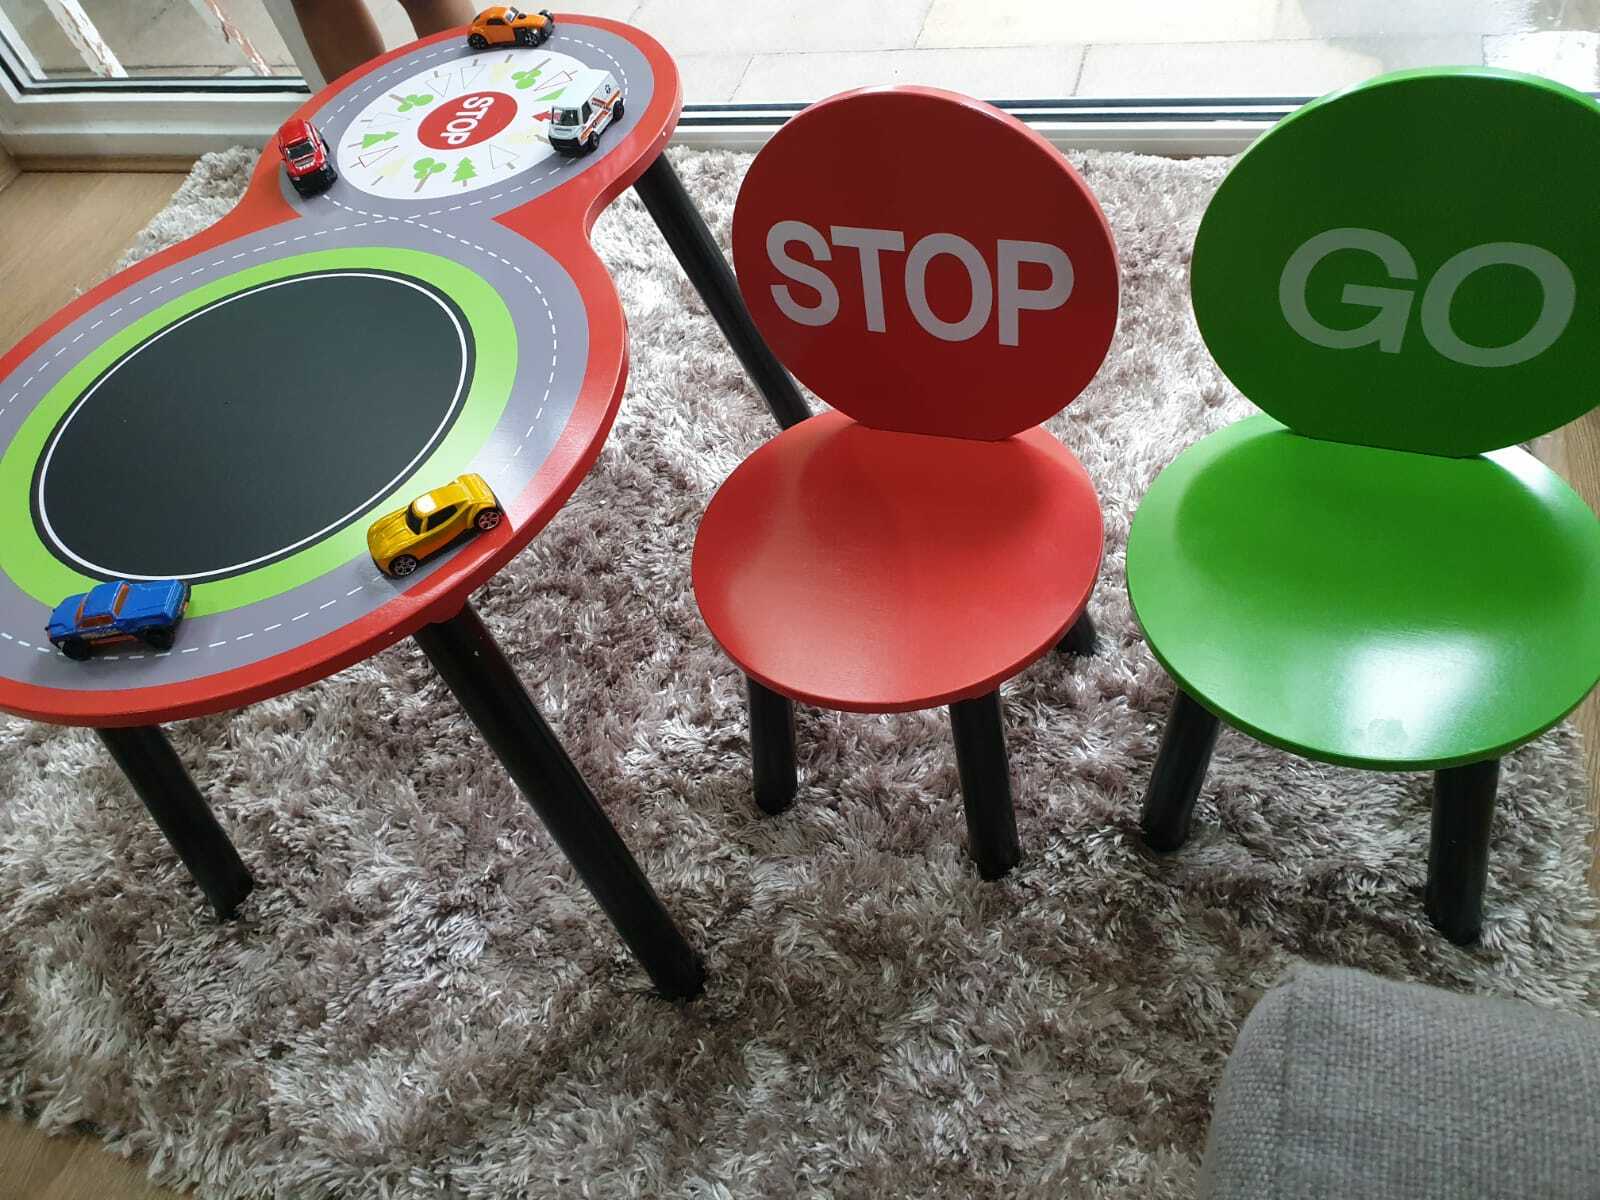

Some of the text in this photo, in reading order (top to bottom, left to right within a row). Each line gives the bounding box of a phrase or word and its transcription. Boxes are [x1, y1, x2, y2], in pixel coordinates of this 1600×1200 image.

[440, 96, 495, 145] STOP
[765, 220, 1075, 347] STOP
[1278, 227, 1577, 368] GO
